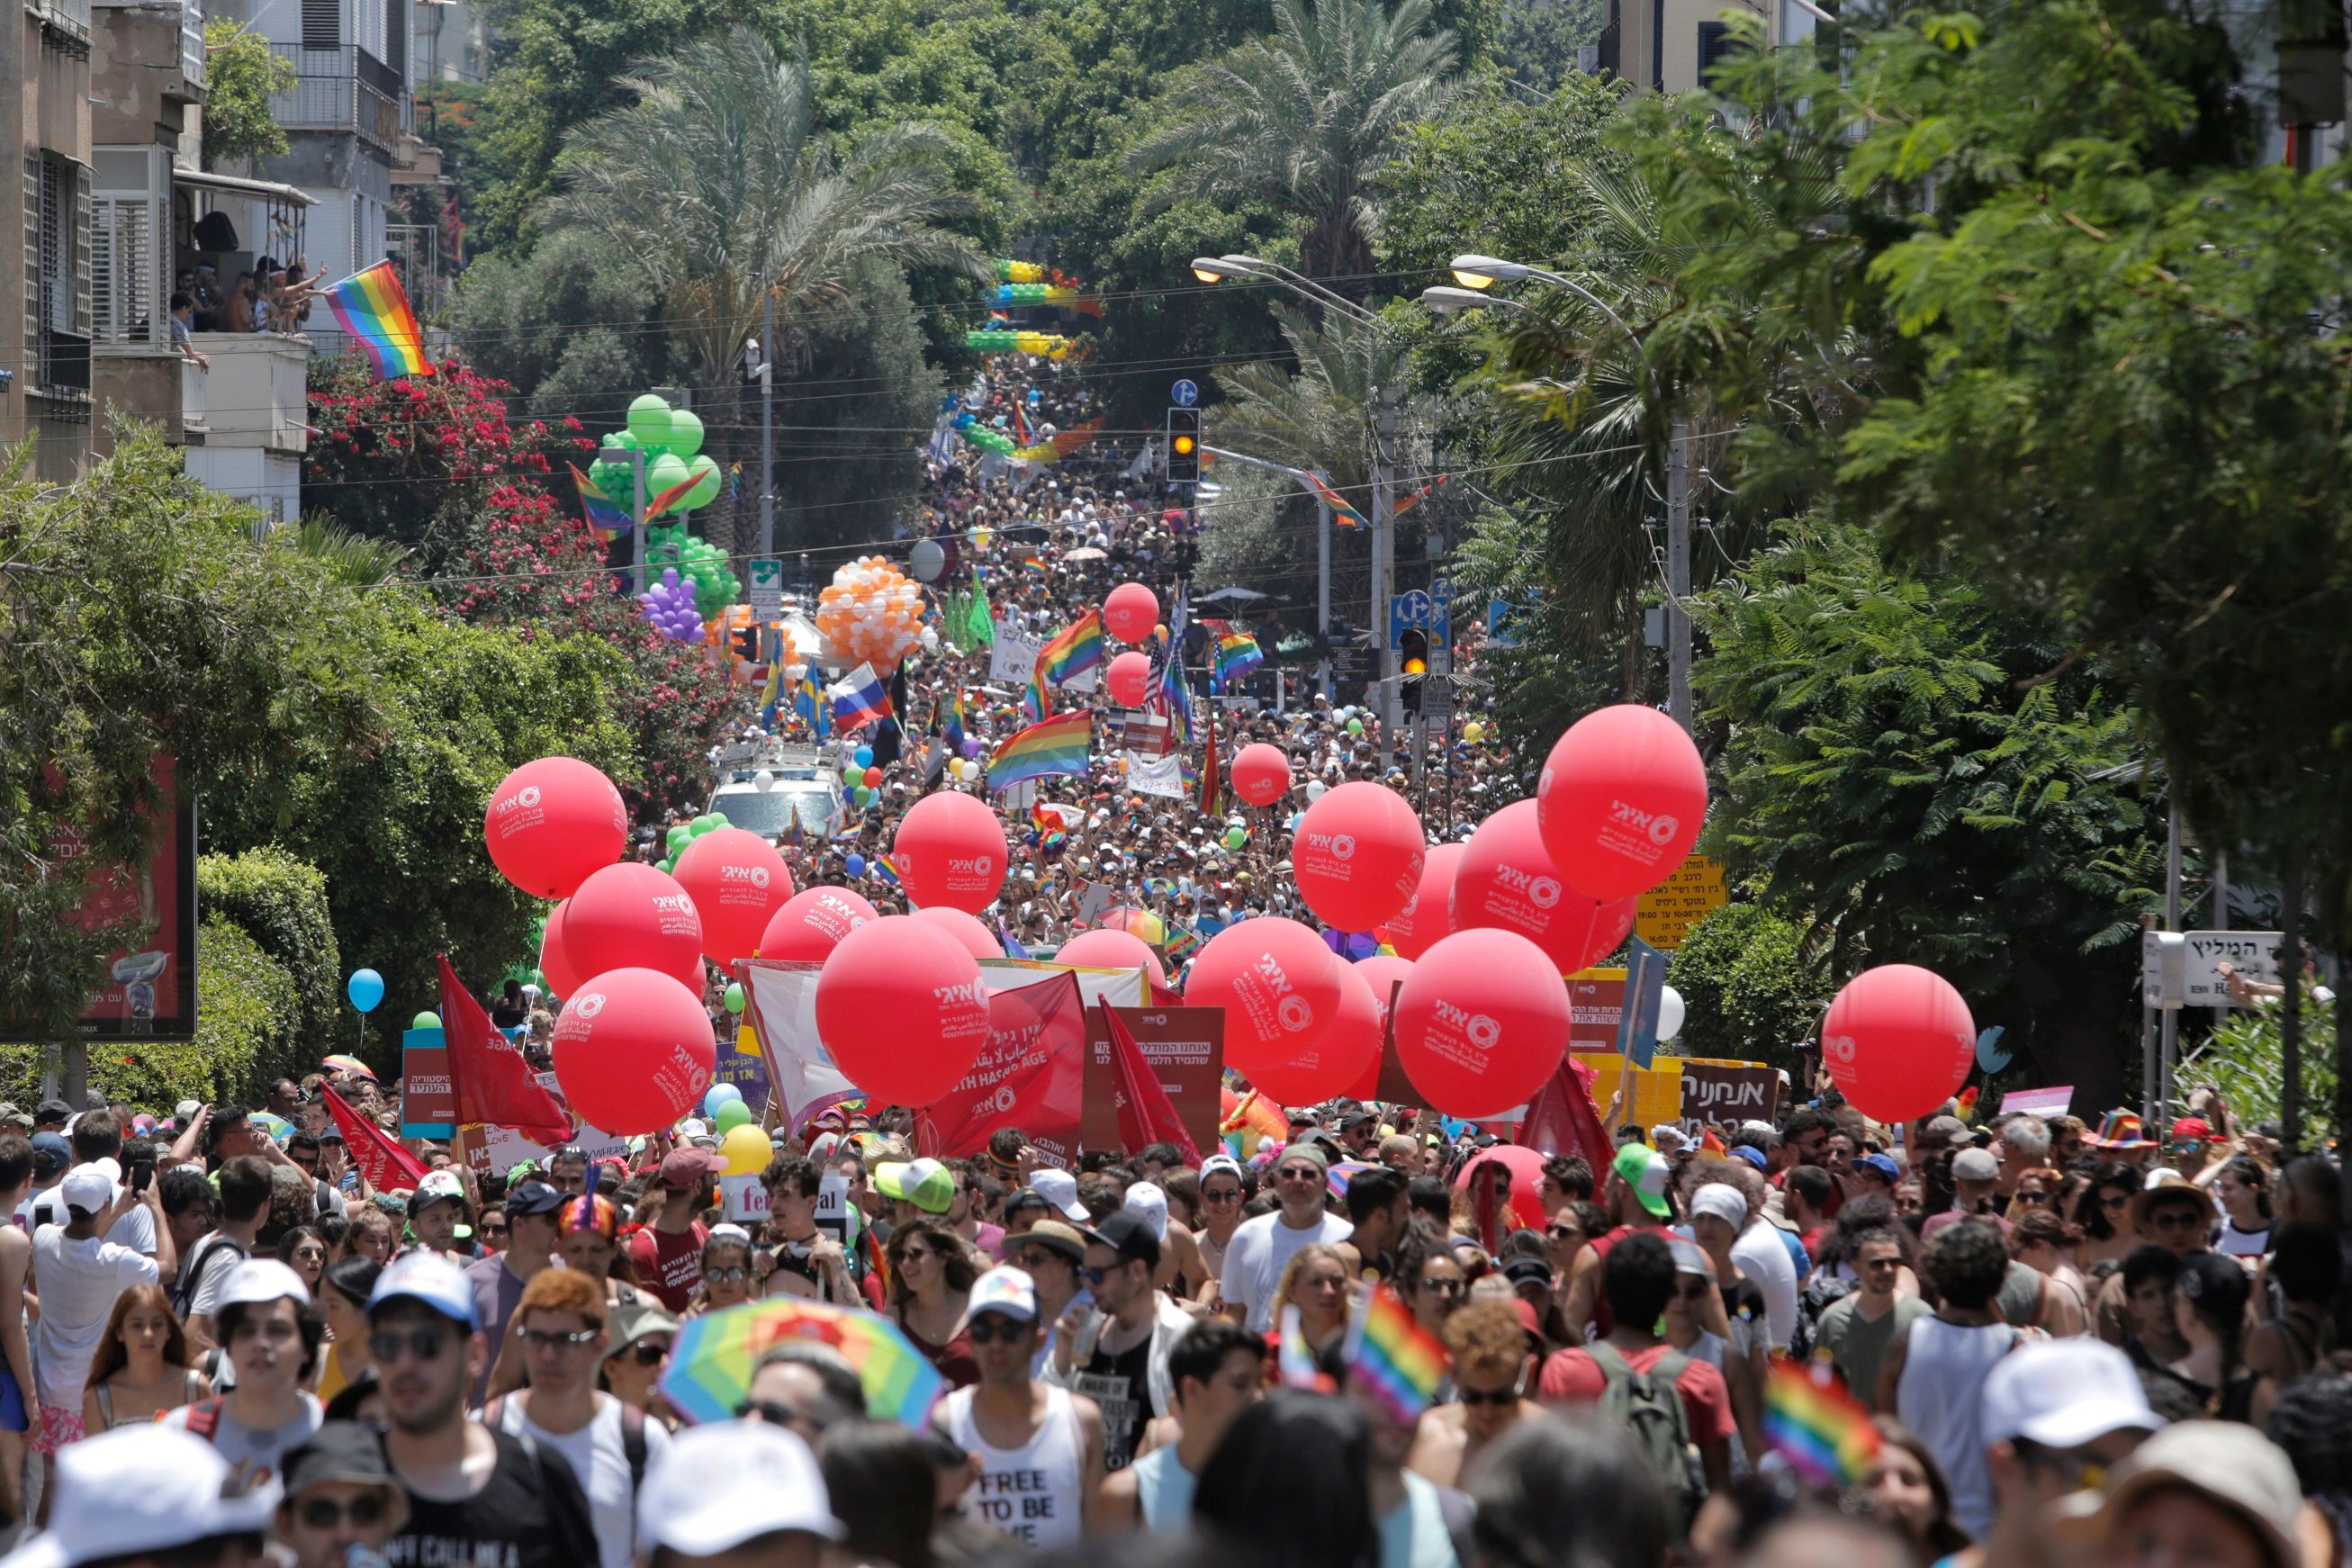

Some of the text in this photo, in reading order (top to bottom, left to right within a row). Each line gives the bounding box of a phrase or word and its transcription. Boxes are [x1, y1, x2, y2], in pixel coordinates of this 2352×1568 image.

[496, 795, 518, 815] איגי
[1612, 799, 1653, 828] איגי
[1309, 833, 1332, 849] איגי
[720, 865, 750, 879] איגי
[948, 859, 974, 870] איגי
[1497, 864, 1531, 889] איגי
[1683, 872, 1702, 882] לרכב
[1709, 885, 1719, 894] בין
[652, 896, 679, 909] איגי
[821, 893, 857, 918] איגי
[1655, 897, 1707, 906] בתוקף בימים
[1637, 911, 1657, 919] 19:00
[803, 917, 824, 931] YOUTH
[2192, 938, 2257, 960] המליץ
[1260, 952, 1293, 996] איגי
[933, 983, 973, 1004] איגי
[1434, 999, 1469, 1028] איגי
[1578, 1014, 1593, 1023] את
[993, 1028, 1017, 1045] גיל
[1181, 1042, 1210, 1052] אנחנו
[674, 1043, 698, 1075] איגי
[1022, 1050, 1048, 1068] AGE
[1174, 1055, 1209, 1065] שתמיד
[410, 1083, 446, 1093] העתיד
[1698, 1081, 1764, 1108] אנחנו
[486, 1134, 509, 1145] LOVE
[1037, 1149, 1051, 1164] אם
[666, 1273, 689, 1289] YOUTH
[980, 1469, 1047, 1494] FREE
[978, 1496, 1054, 1521] TO BE
